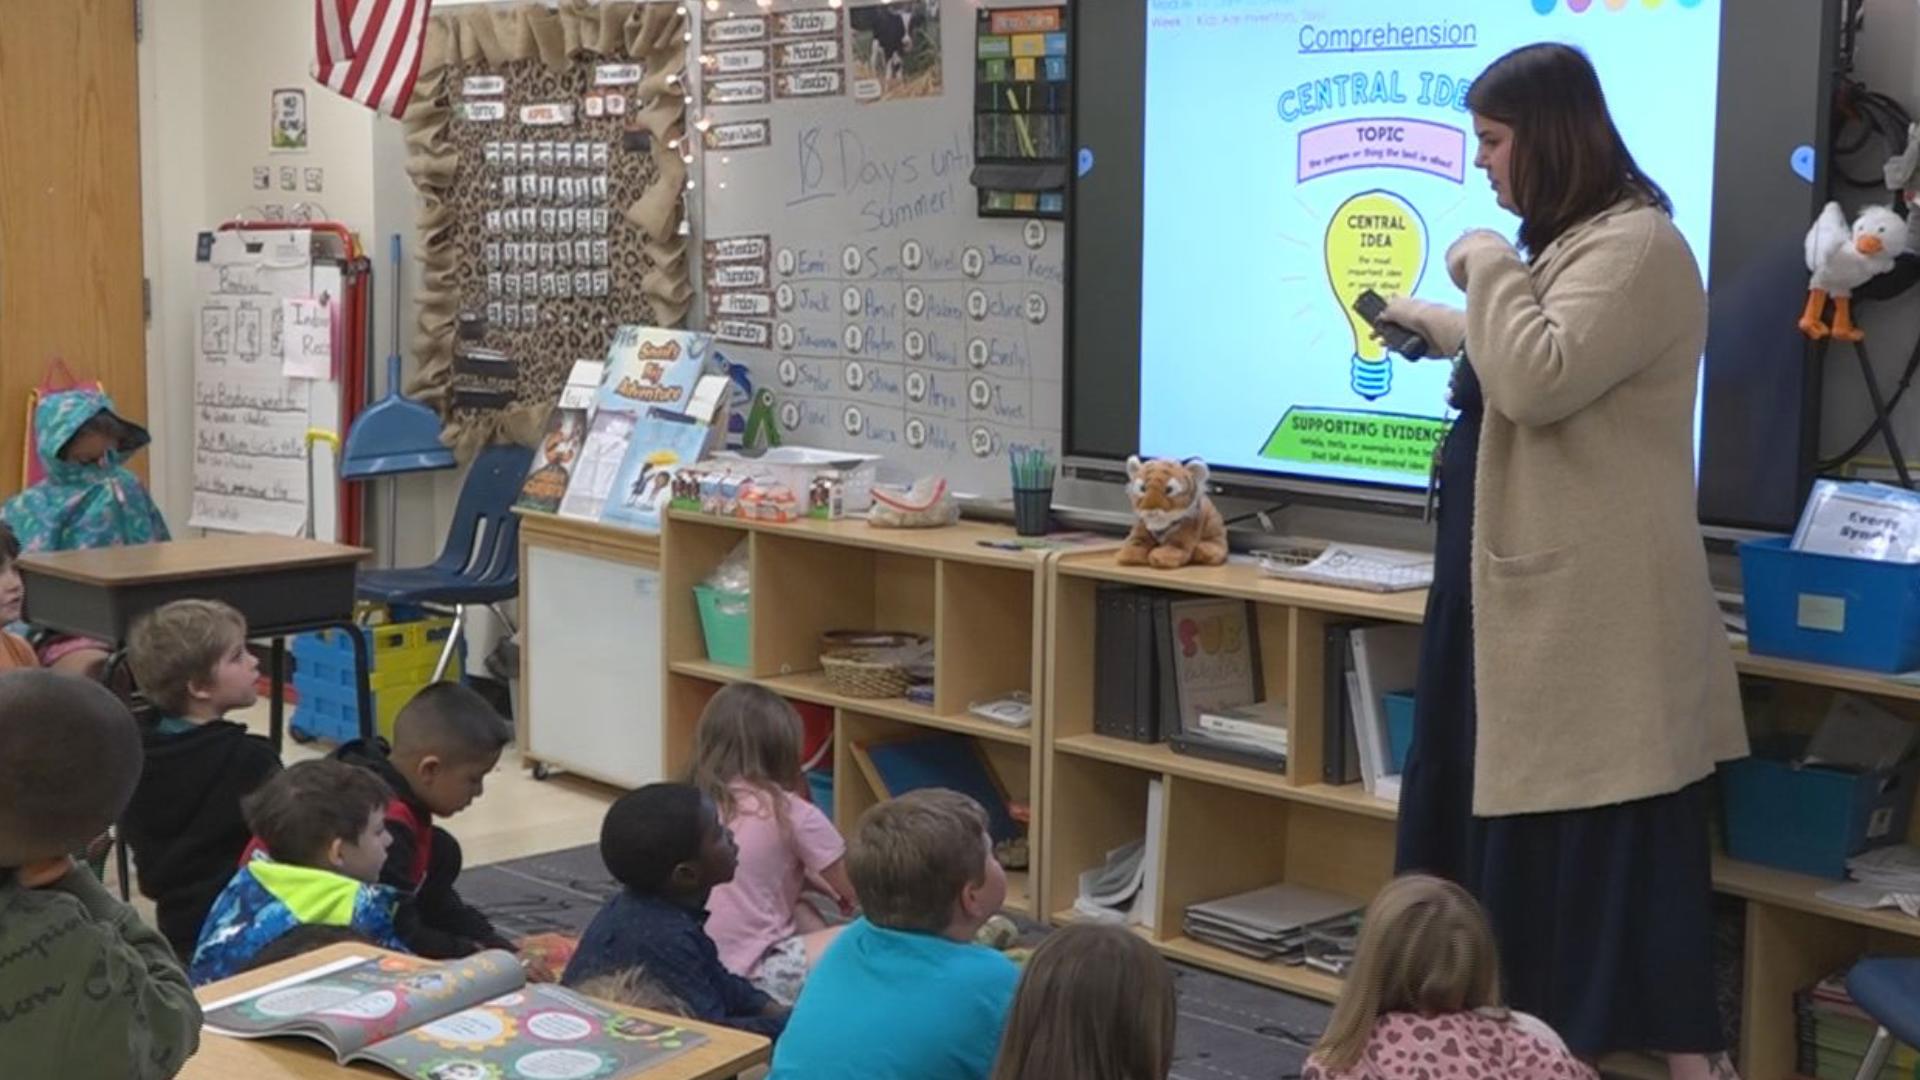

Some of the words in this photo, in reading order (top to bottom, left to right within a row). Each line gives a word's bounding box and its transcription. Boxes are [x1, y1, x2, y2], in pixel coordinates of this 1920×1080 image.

[791, 12, 825, 31] Sunday
[1298, 20, 1477, 51] Comprehension
[792, 41, 829, 61] Monday
[1278, 71, 1407, 123] CENTRAL
[1417, 72, 1470, 113] IDE
[1357, 127, 1405, 142] TOPIC
[834, 128, 918, 192] Days
[1347, 214, 1407, 230] CENTRAL
[1360, 233, 1392, 248] IDEA
[719, 319, 762, 339] Saturday
[1291, 416, 1378, 437] SUPPORTING
[1382, 424, 1442, 443] EVIDENC
